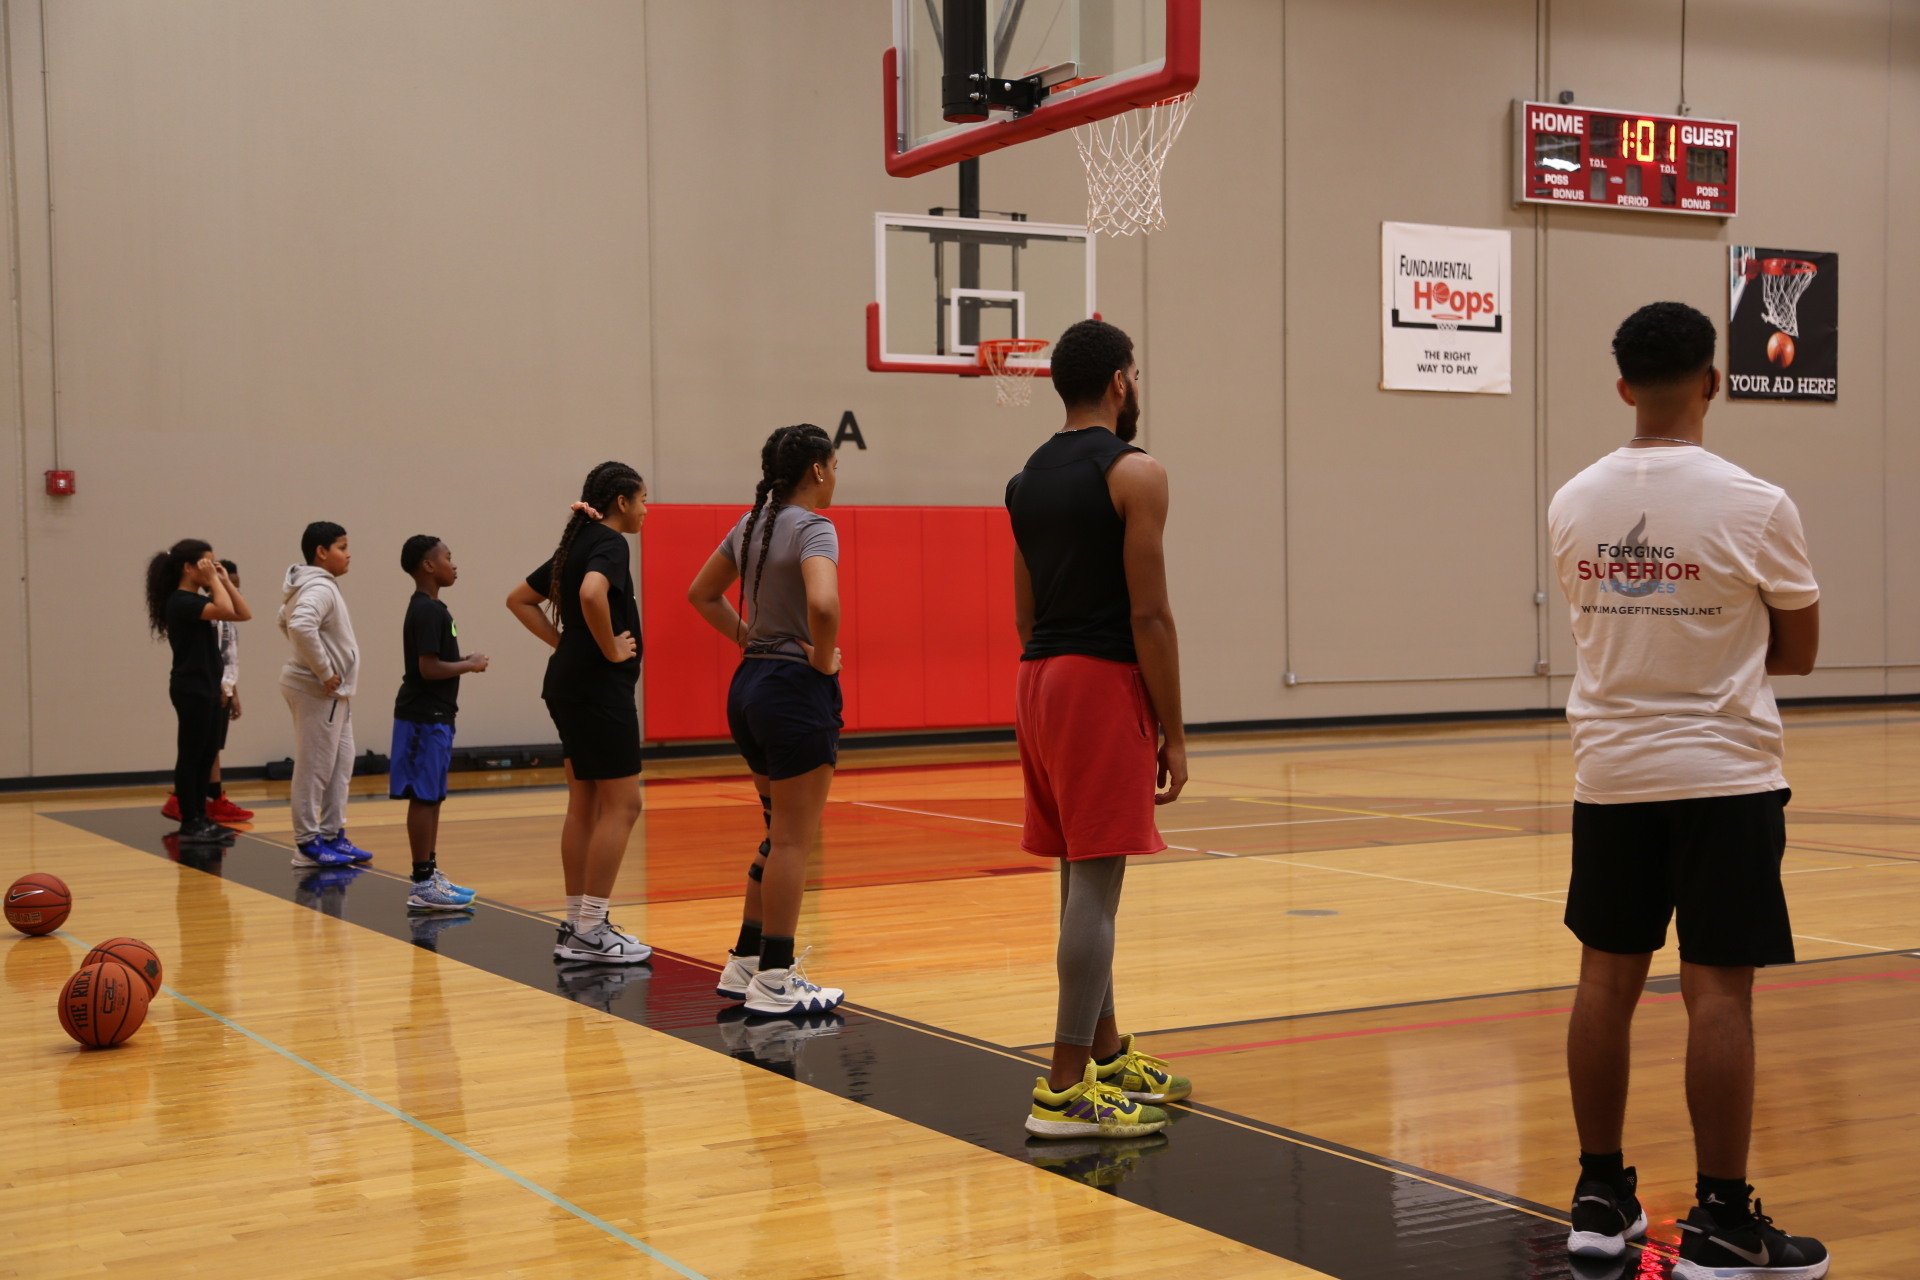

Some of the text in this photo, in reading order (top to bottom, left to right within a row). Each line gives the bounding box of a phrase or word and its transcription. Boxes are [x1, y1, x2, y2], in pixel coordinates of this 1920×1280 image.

[1531, 111, 1584, 134] HOME
[1621, 119, 1676, 163] 1:01
[1681, 125, 1734, 148] GUEST
[1544, 174, 1569, 185] POSS
[1552, 188, 1584, 200] BONUS
[1617, 195, 1649, 207] PERIOD
[1696, 186, 1719, 197] POSS
[1681, 198, 1711, 210] BONUS
[1400, 255, 1473, 280] FUNDAMENTAL
[1413, 281, 1495, 320] Hoops
[1424, 350, 1471, 361] THE RIGHT
[1417, 364, 1478, 375] WAY TO PLAY
[1730, 374, 1836, 395] YOUR AD HERE
[833, 410, 867, 450] A
[1597, 543, 1675, 559] FORGING
[1577, 560, 1701, 581] SUPERIOR
[70, 1004, 88, 1028] THE
